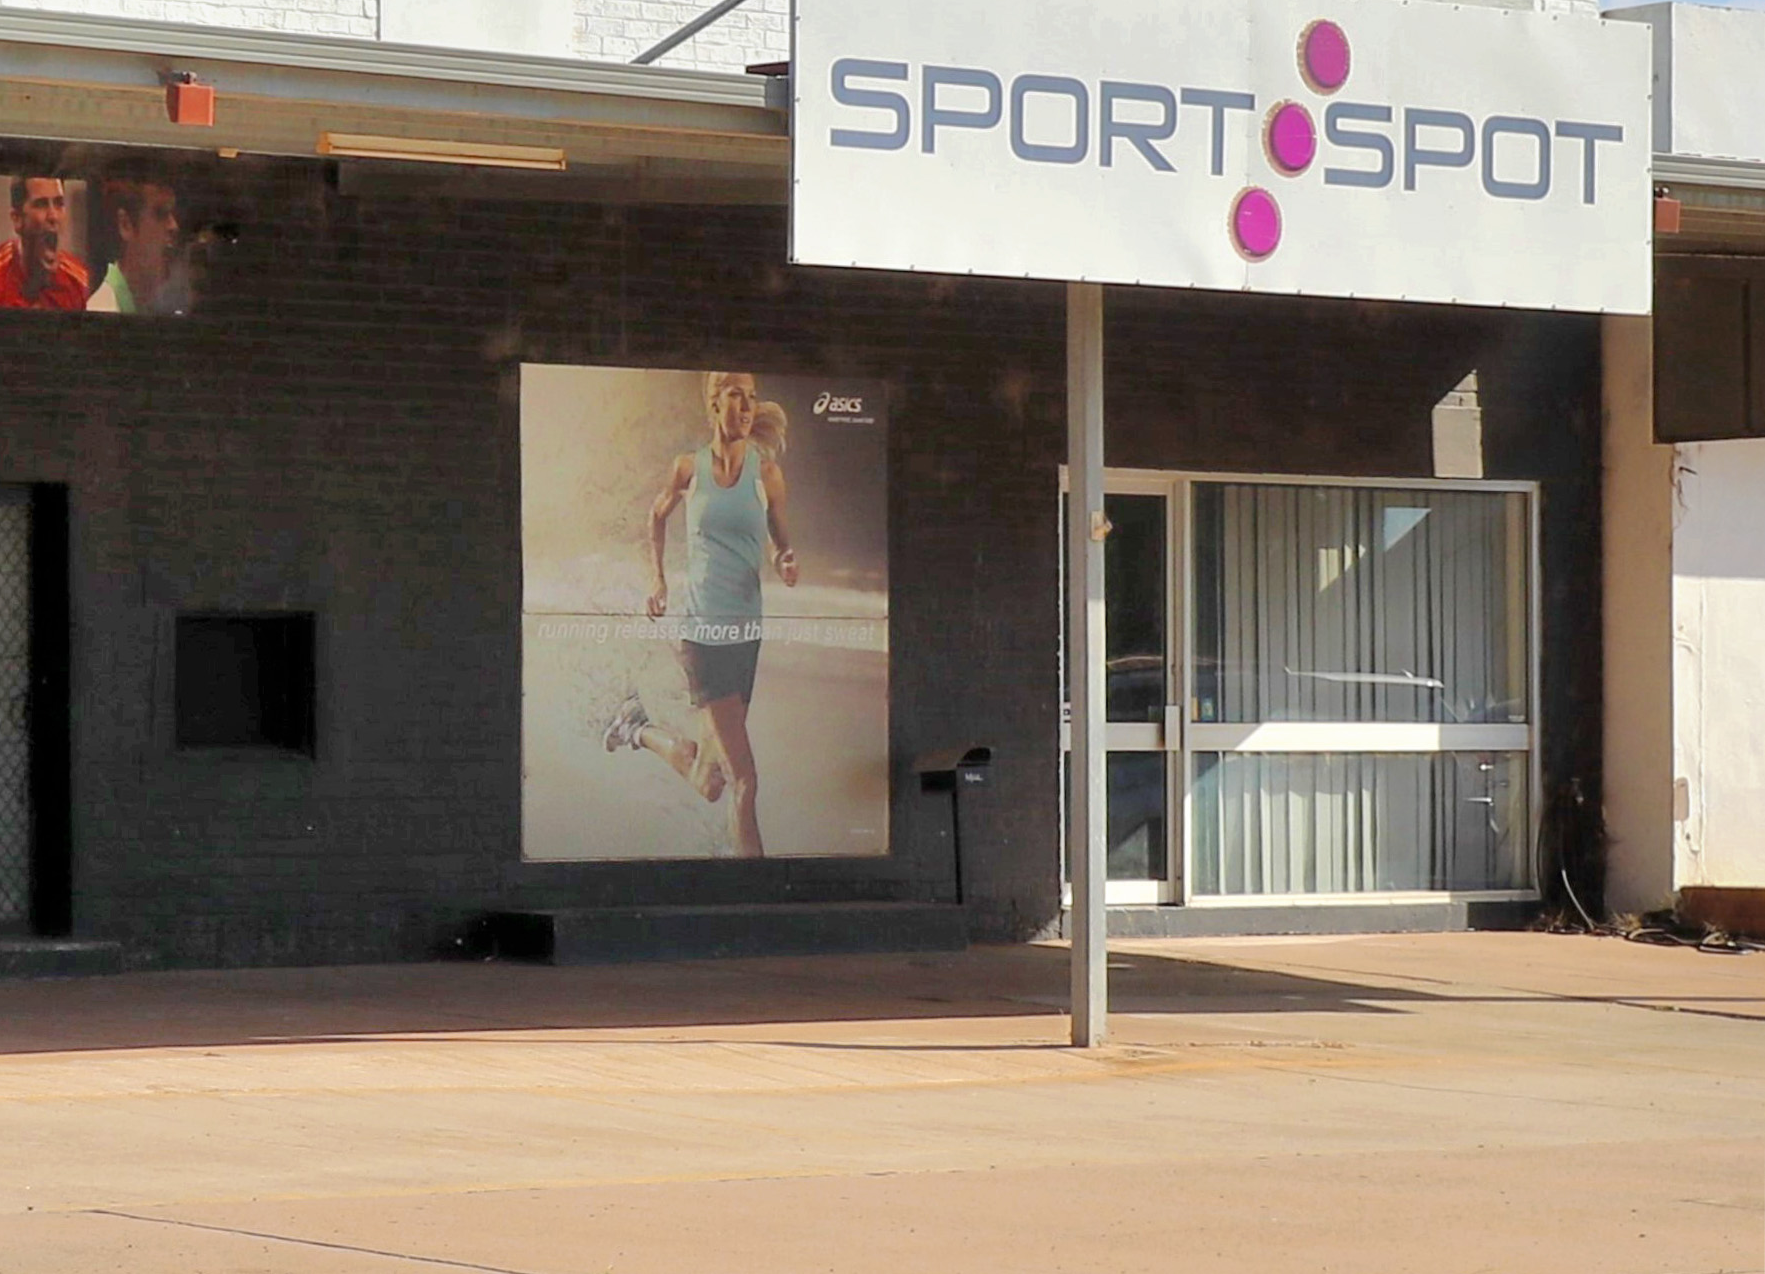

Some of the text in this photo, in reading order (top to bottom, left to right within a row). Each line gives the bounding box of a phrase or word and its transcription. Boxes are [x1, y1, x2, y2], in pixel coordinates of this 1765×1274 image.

[829, 56, 1624, 206] SPORT SPOT
[828, 396, 863, 413] asics
[537, 620, 876, 645] running releases more than just sweat
